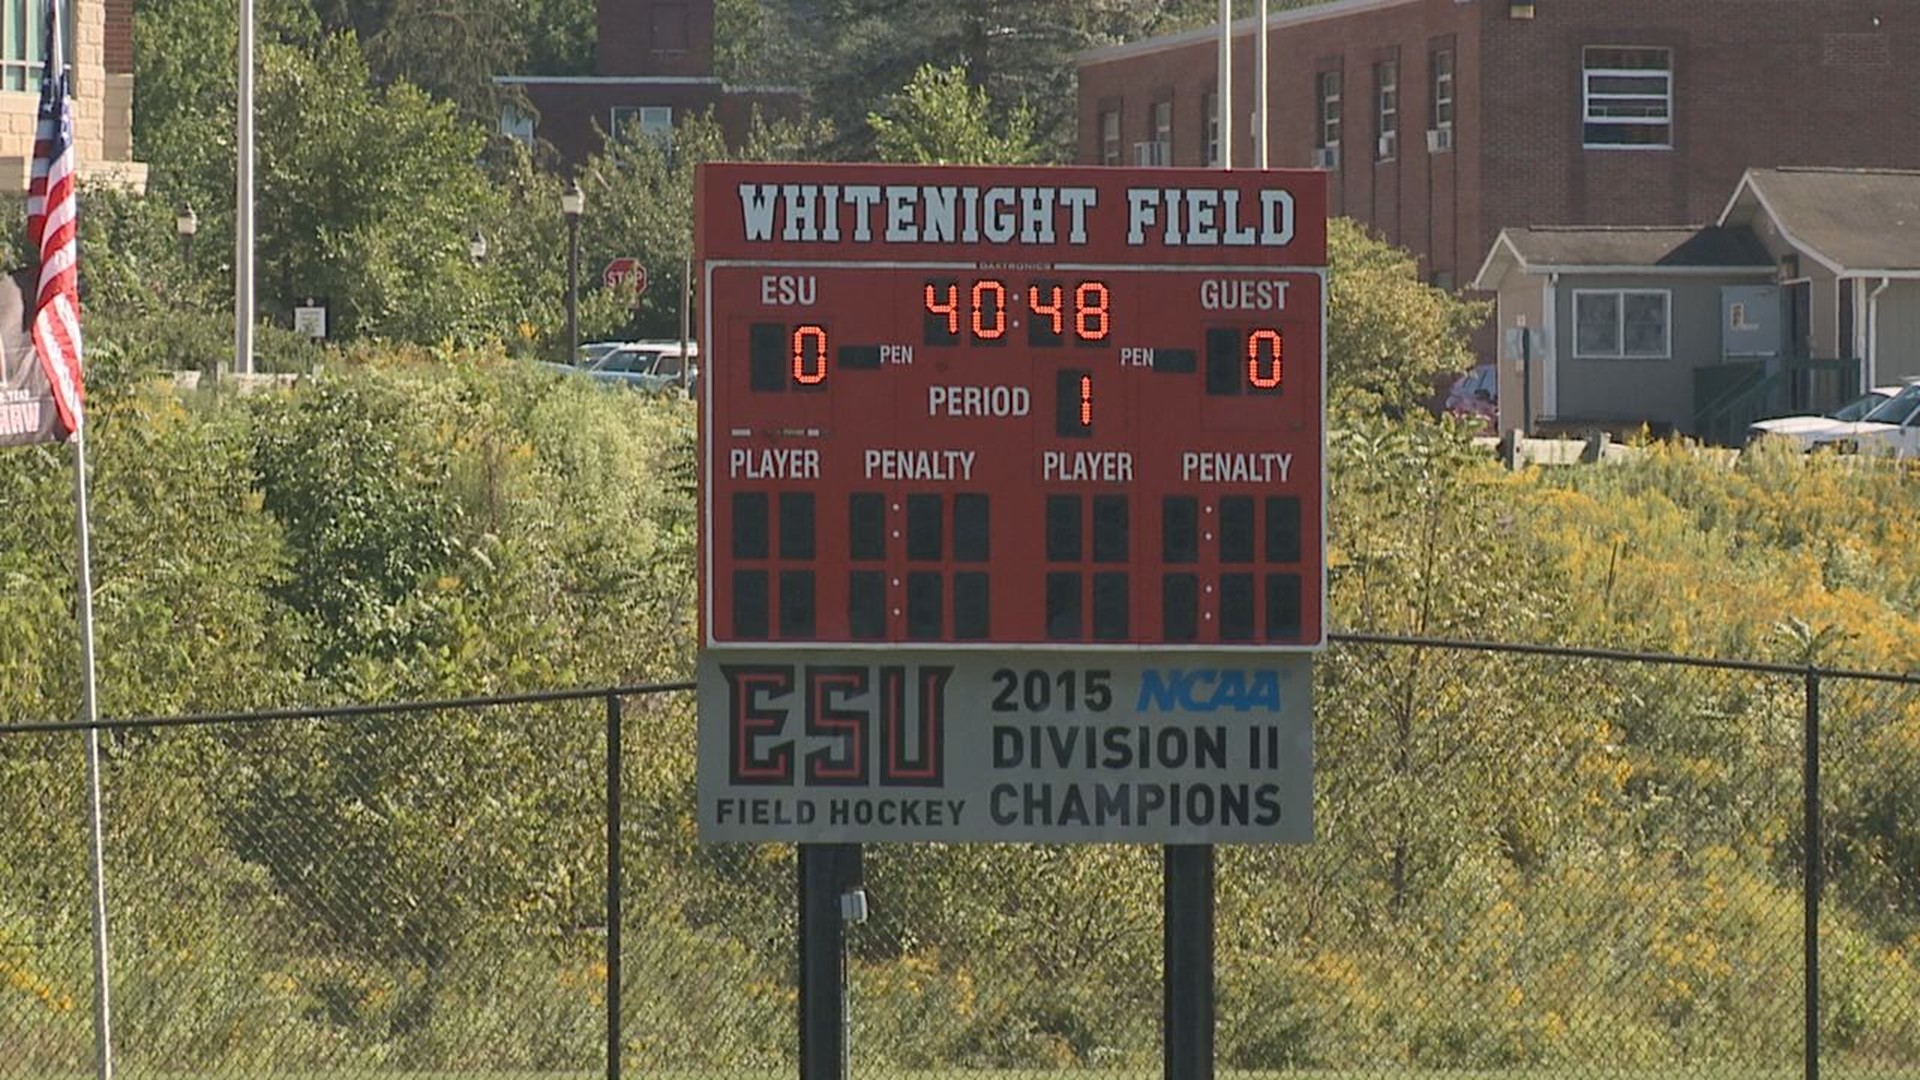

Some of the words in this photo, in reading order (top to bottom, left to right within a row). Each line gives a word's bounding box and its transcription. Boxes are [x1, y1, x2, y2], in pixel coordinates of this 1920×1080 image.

[739, 184, 1097, 245] WHITENIGHT
[1126, 189, 1295, 247] FIELD
[761, 275, 816, 305] ESU
[1200, 280, 1290, 310] GUEST
[926, 281, 1110, 339] 40:48
[791, 325, 828, 385] 0
[879, 345, 913, 365] PEN
[1120, 347, 1154, 367] PEN
[1246, 328, 1284, 389] 0
[929, 386, 1030, 417] PERIOD
[1079, 373, 1093, 426] 1
[730, 449, 820, 478] PLAYER
[864, 450, 976, 480] PENALTY
[1043, 452, 1134, 481] PLAYER
[1182, 453, 1293, 483] PENALTY
[991, 669, 1112, 712] 2015
[1135, 669, 1282, 712] NCAA
[719, 664, 955, 786] ESU
[992, 726, 1227, 769] DIVISION
[1249, 726, 1279, 769] II
[716, 799, 816, 825] FIELD
[829, 799, 966, 826] HOCKEY
[989, 782, 1281, 827] CHAMPIONS
